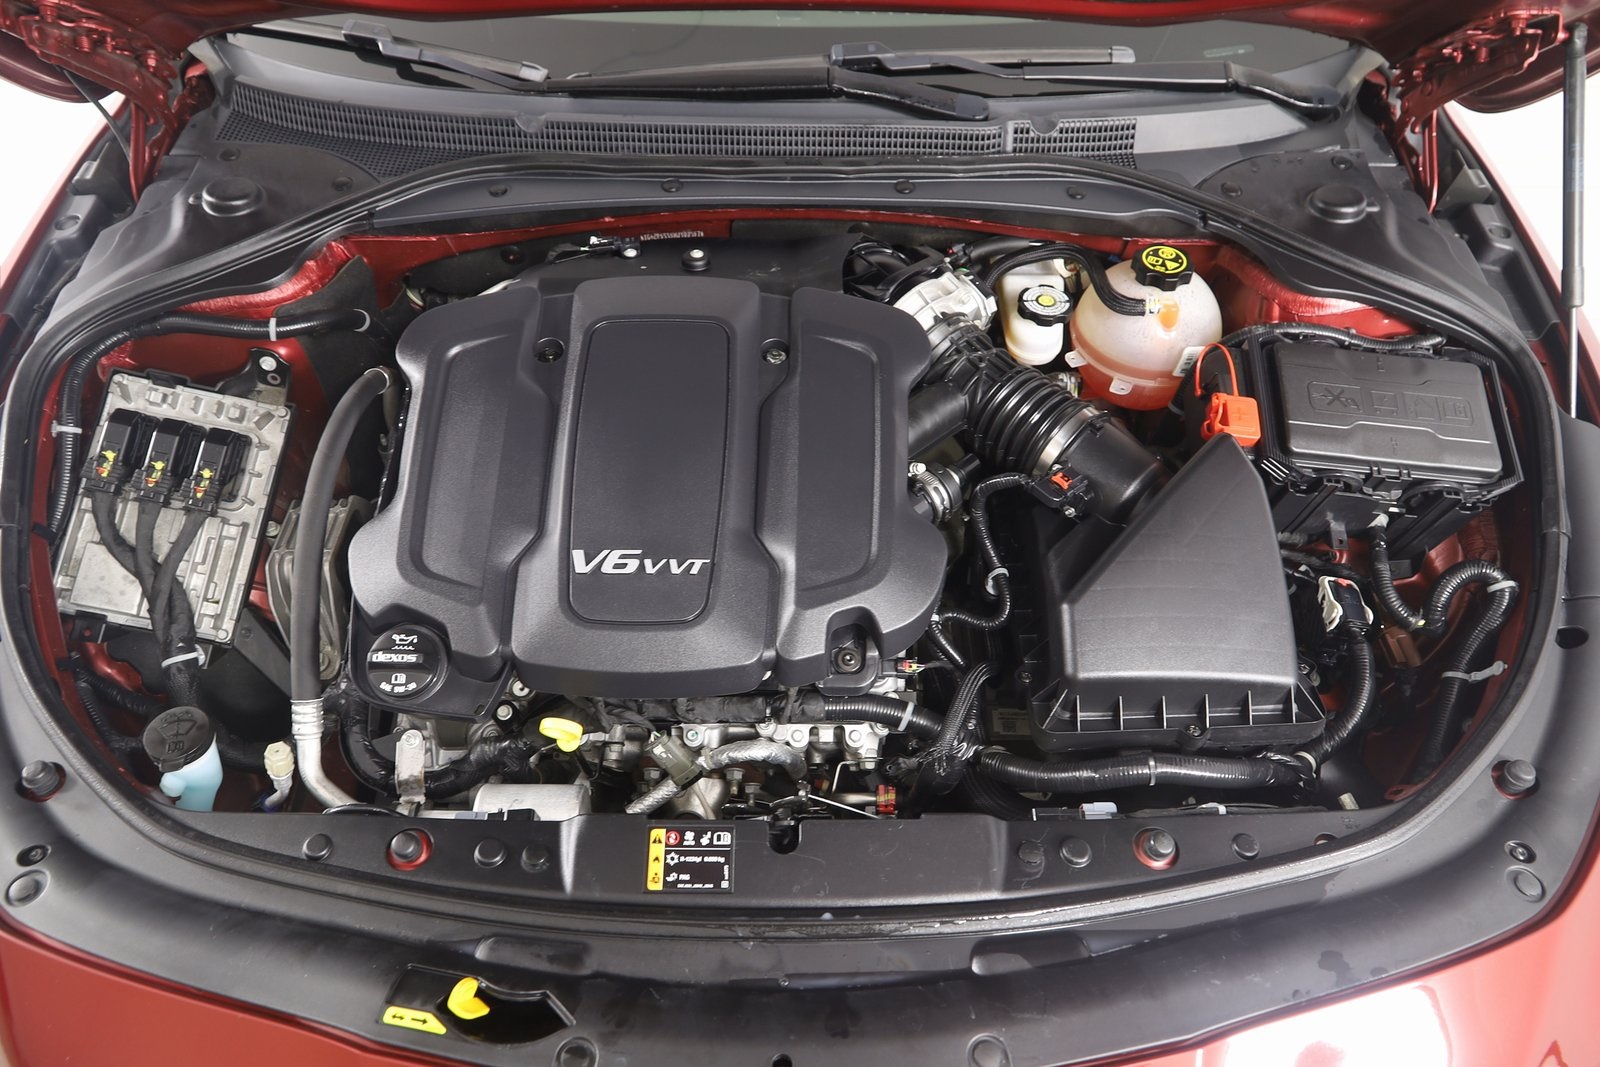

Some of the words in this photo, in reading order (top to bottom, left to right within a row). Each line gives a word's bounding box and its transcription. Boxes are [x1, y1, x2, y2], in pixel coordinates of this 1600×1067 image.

[572, 549, 643, 574] V6
[643, 558, 711, 574] VVT
[372, 650, 418, 662] dexos
[379, 682, 392, 692] SAE
